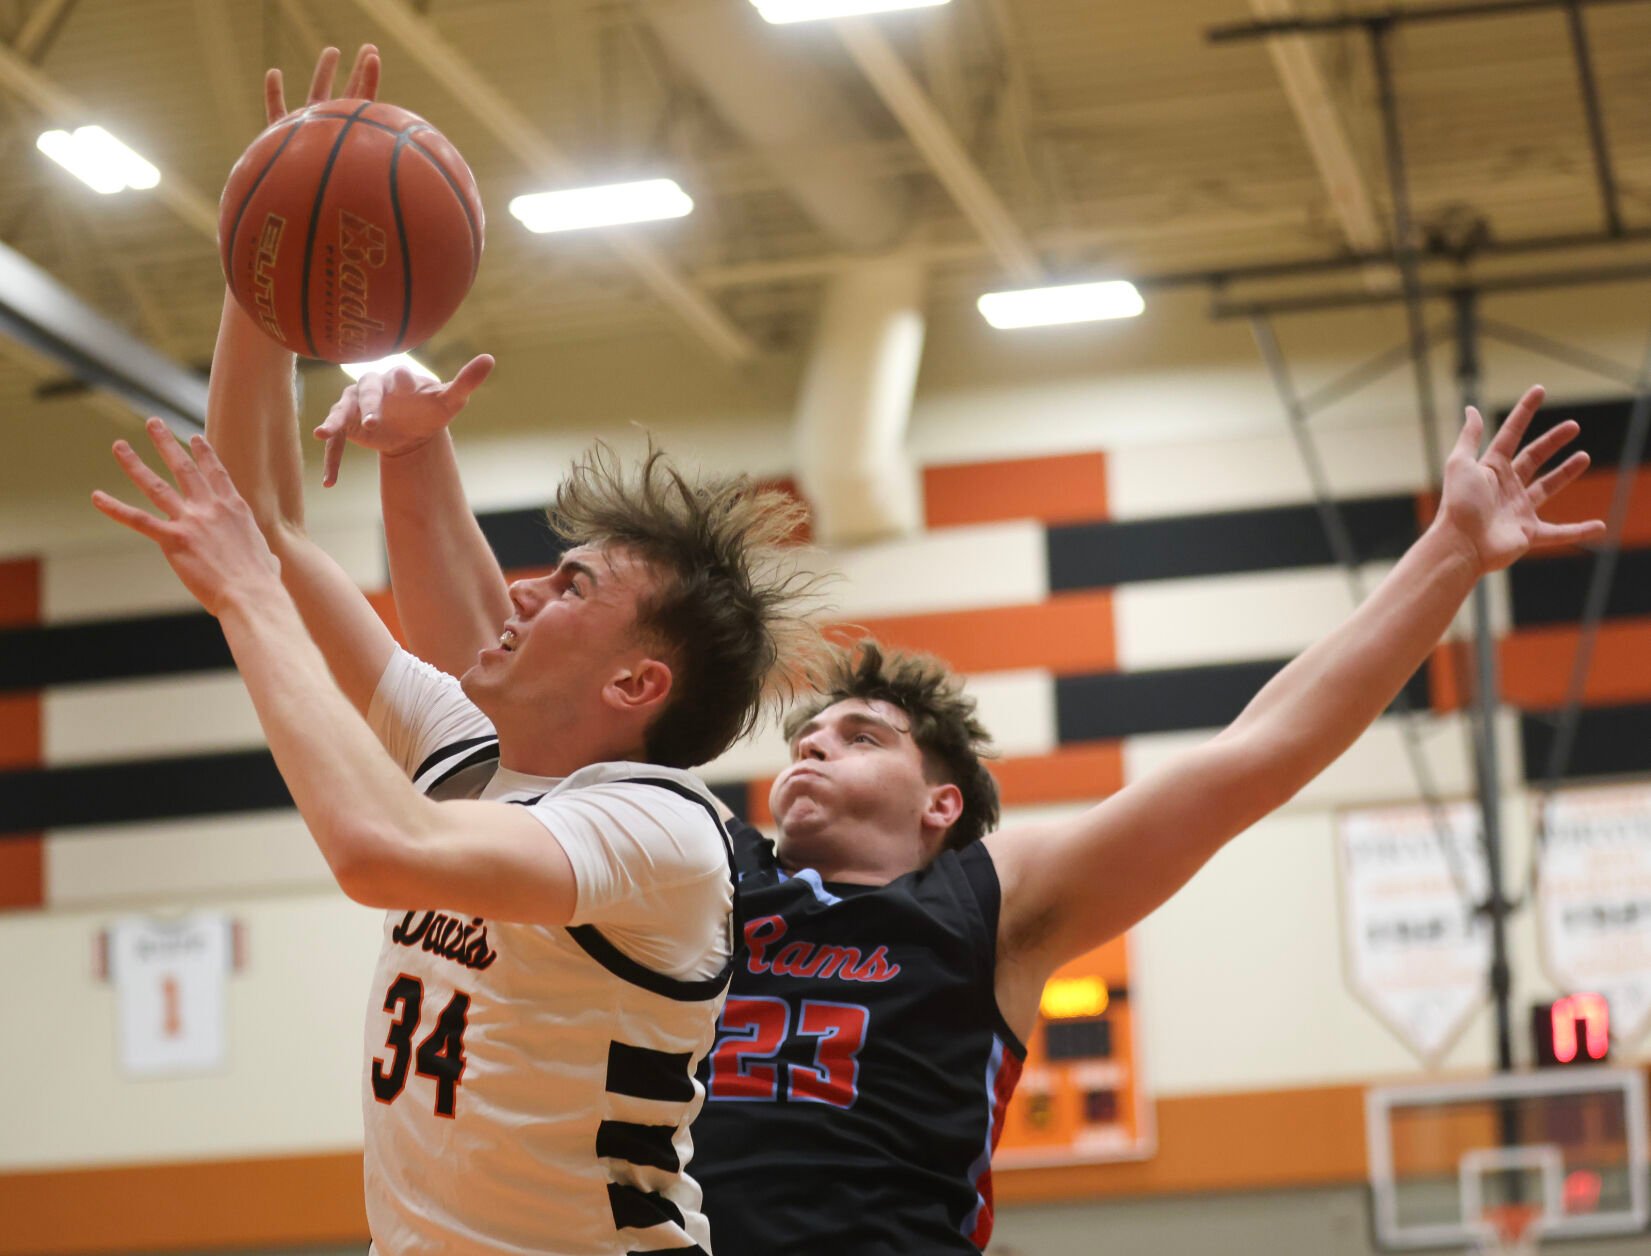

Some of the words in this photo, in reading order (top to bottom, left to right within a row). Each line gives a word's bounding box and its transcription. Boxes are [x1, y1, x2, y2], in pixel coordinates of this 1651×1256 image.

[255, 212, 287, 342] ELITE
[392, 910, 497, 970] Davis
[743, 914, 901, 982] Rams
[371, 972, 471, 1119] 34
[708, 995, 870, 1109] 23
